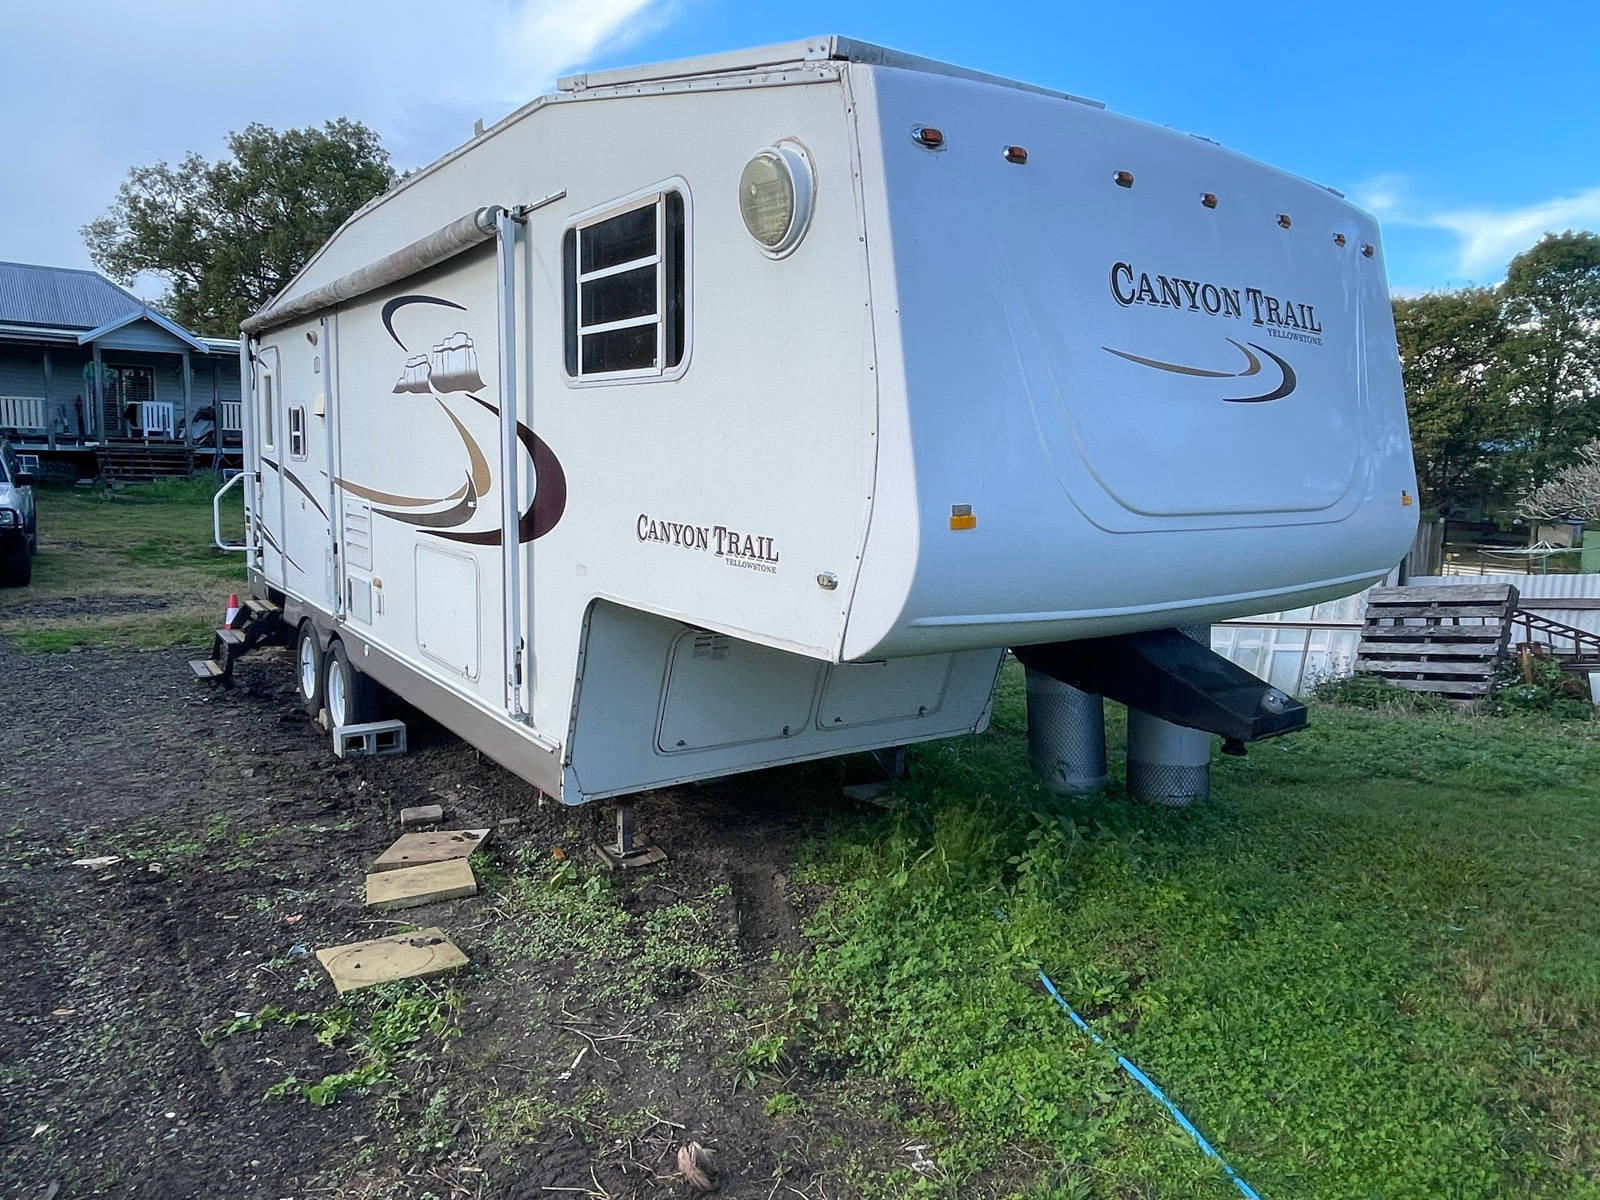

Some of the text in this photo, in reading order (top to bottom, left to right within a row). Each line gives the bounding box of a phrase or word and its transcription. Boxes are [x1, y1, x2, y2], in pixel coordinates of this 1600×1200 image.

[1110, 261, 1322, 335] CANYON TRAIL
[1267, 328, 1323, 346] YELLOWSTONE
[637, 513, 779, 565] CANYON TRAIL
[725, 557, 777, 574] YELLOWSTONE
